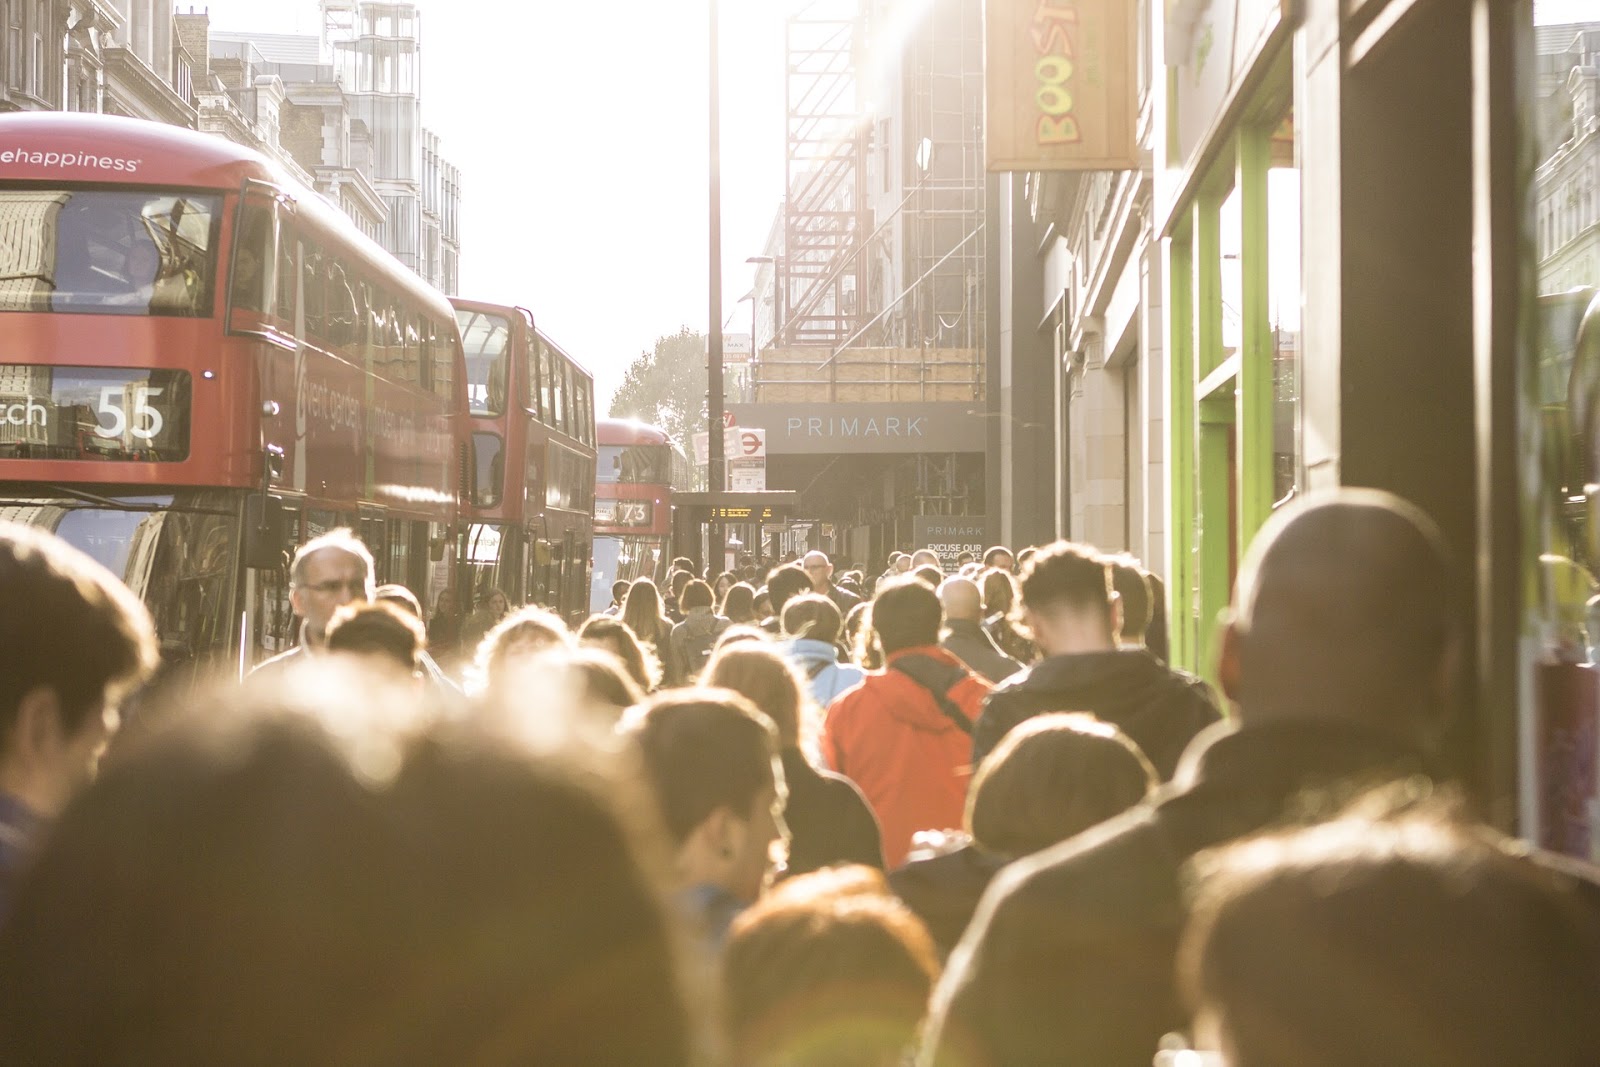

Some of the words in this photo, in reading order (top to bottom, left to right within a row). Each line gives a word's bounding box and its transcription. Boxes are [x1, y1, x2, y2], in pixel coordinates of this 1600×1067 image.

[1032, 0, 1082, 144] BOOST
[94, 386, 164, 439] 55
[787, 417, 922, 436] PRIMARK
[623, 503, 646, 521] 73
[927, 526, 982, 536] PRIMARK
[927, 543, 961, 552] EXCUSE
[963, 543, 982, 552] OUR
